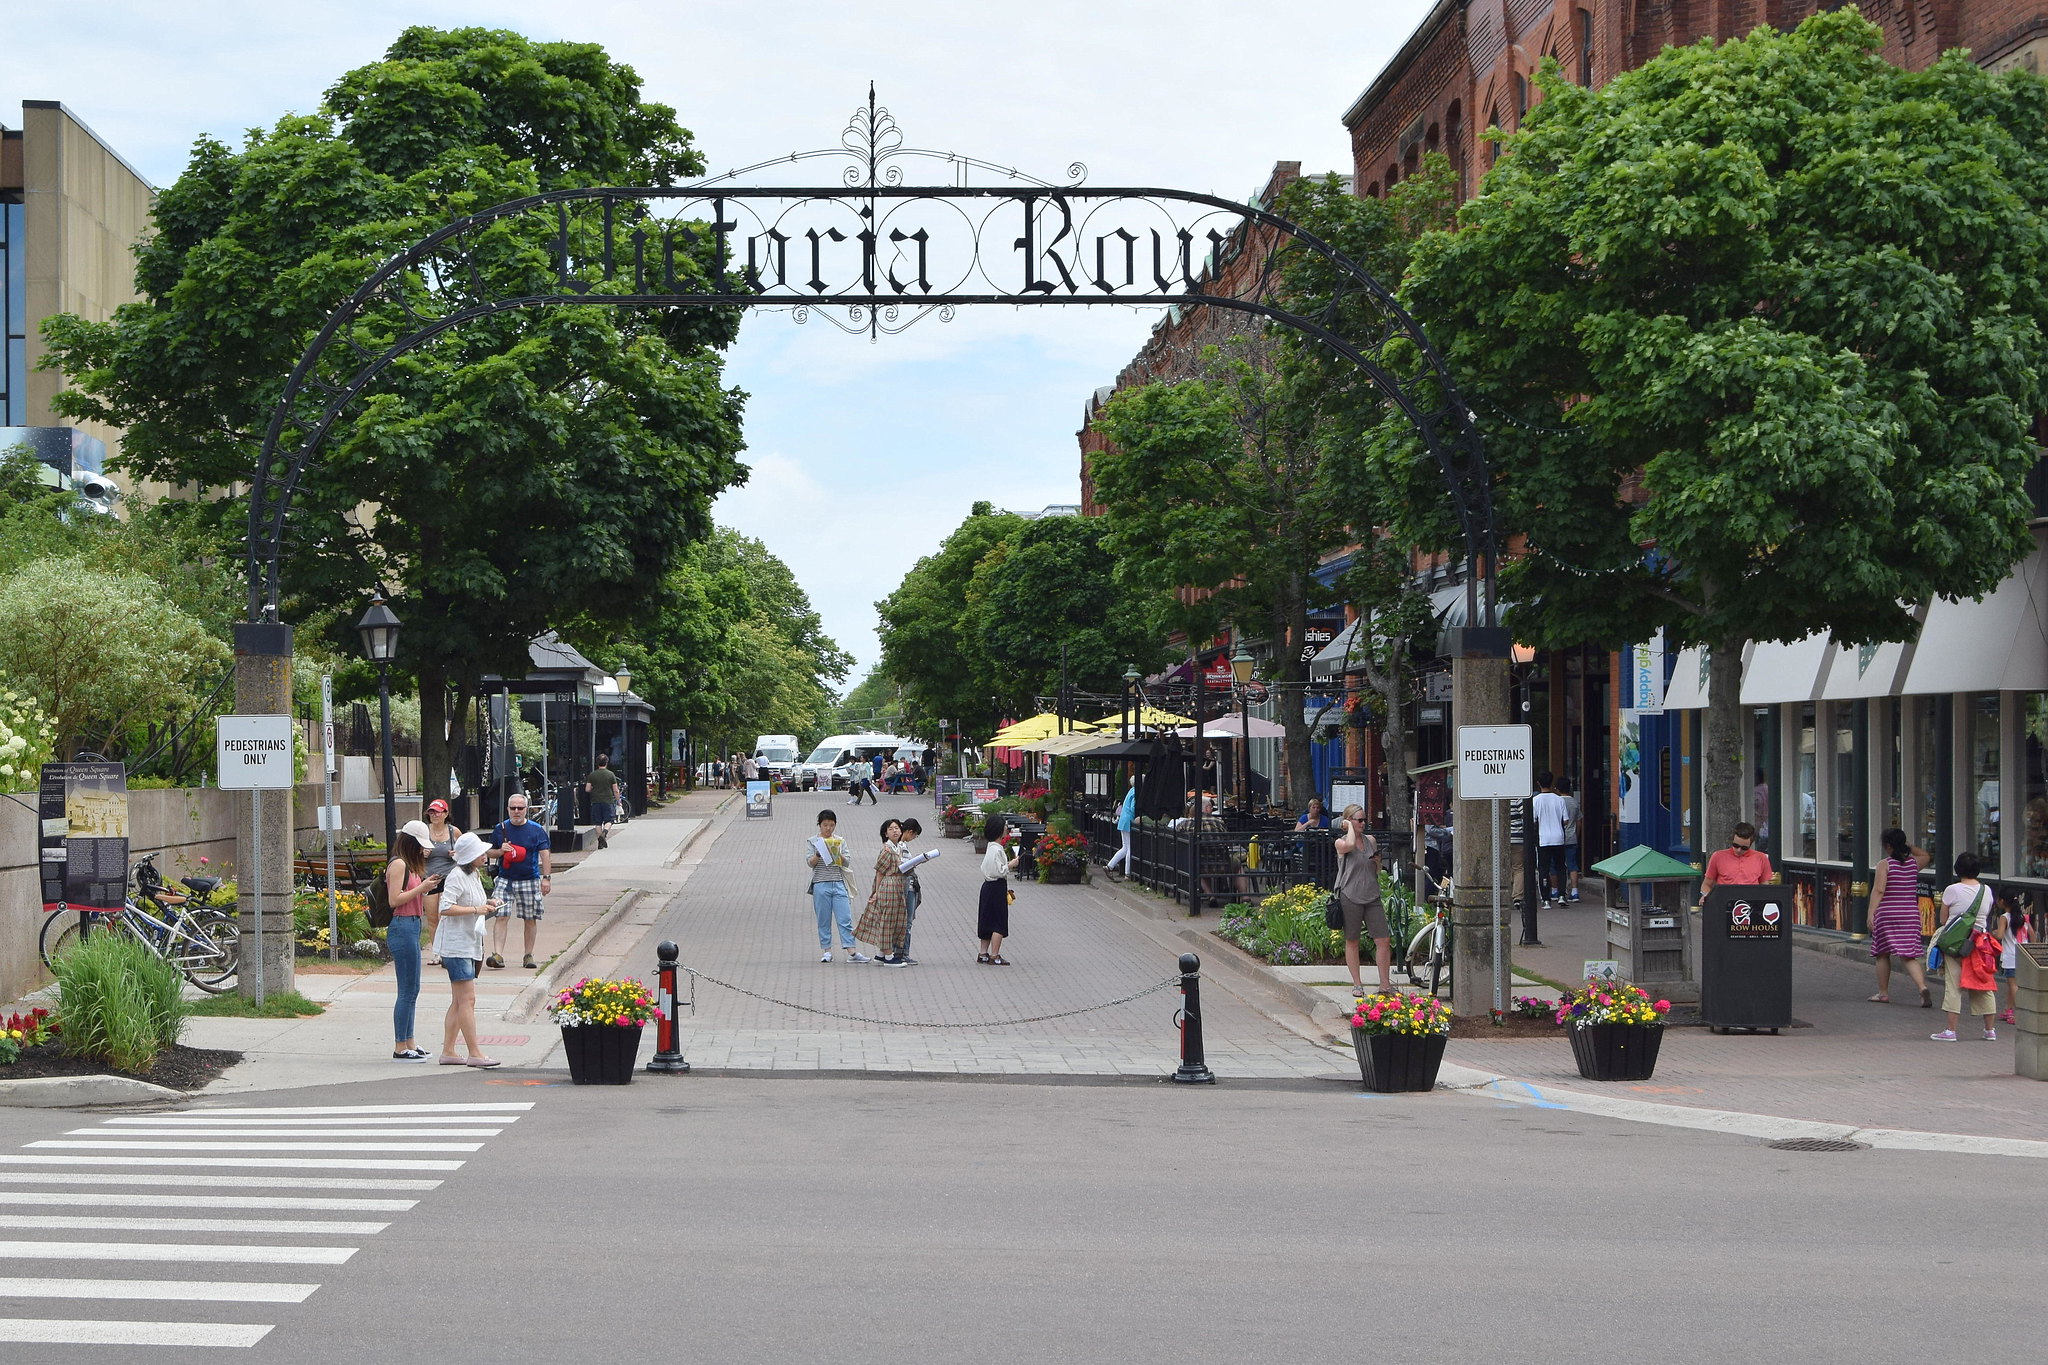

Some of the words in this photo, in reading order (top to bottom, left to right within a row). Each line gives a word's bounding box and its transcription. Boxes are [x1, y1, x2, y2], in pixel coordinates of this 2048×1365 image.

[548, 197, 933, 295] Victoria
[1013, 192, 1227, 295] Row
[1304, 628, 1331, 642] ishies
[224, 739, 286, 751] PEDESTRIANS
[243, 753, 267, 765] ONLY
[1465, 749, 1525, 761] PEDESTRIANS
[69, 766, 88, 774] Queen
[90, 766, 109, 774] Square
[1483, 763, 1506, 774] ONLY
